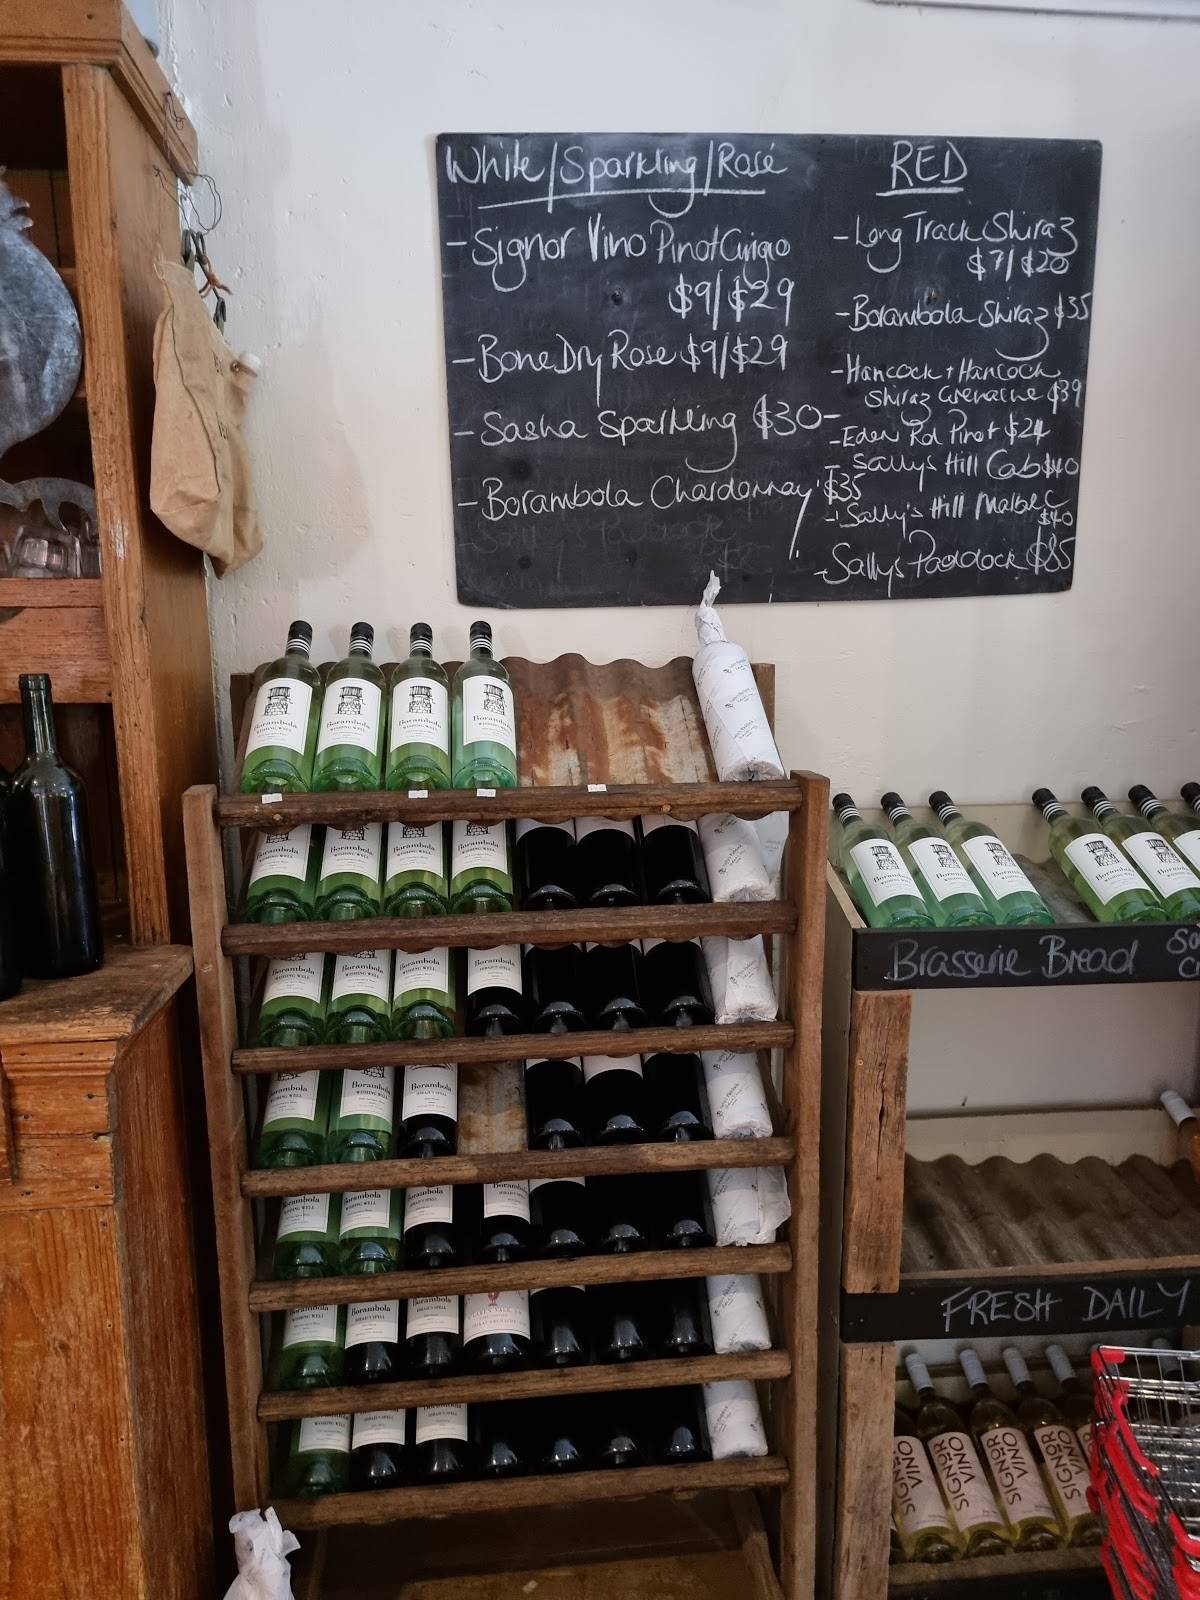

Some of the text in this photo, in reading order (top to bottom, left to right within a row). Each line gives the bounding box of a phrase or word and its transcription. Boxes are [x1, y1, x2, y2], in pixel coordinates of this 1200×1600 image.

[890, 140, 968, 190] RED
[471, 226, 576, 292] Signor
[587, 212, 647, 262] Vino
[650, 219, 720, 264] Pinot
[855, 208, 1079, 274] Long Track Shiraz
[978, 296, 1050, 361] Shiraz
[1054, 291, 1092, 330] $35
[477, 333, 556, 384] Bone
[554, 333, 603, 408] Dry
[607, 329, 677, 371] Rose
[846, 353, 943, 385] Hancock
[957, 357, 1062, 384] Hancock
[864, 385, 932, 427] Shiraz
[1046, 379, 1083, 416] $39
[947, 408, 1001, 446] Pinot
[479, 410, 590, 447] Sasha
[944, 450, 978, 477] Hill
[986, 449, 1041, 480] Cab
[1040, 452, 1080, 479] $40
[481, 476, 643, 522] Borambola
[930, 494, 964, 520] Hill
[1036, 508, 1075, 529] $40
[907, 529, 1030, 579] Paddock
[884, 934, 1139, 983] Brasserie Bread
[411, 1081, 452, 1093] Borambola
[351, 1303, 392, 1317] Borambola
[940, 1279, 1191, 1333] FRESH DAILY
[897, 1440, 924, 1490] VINO
[948, 1436, 976, 1485] VINO
[1002, 1431, 1029, 1479] VINO
[1057, 1429, 1086, 1475] VINO
